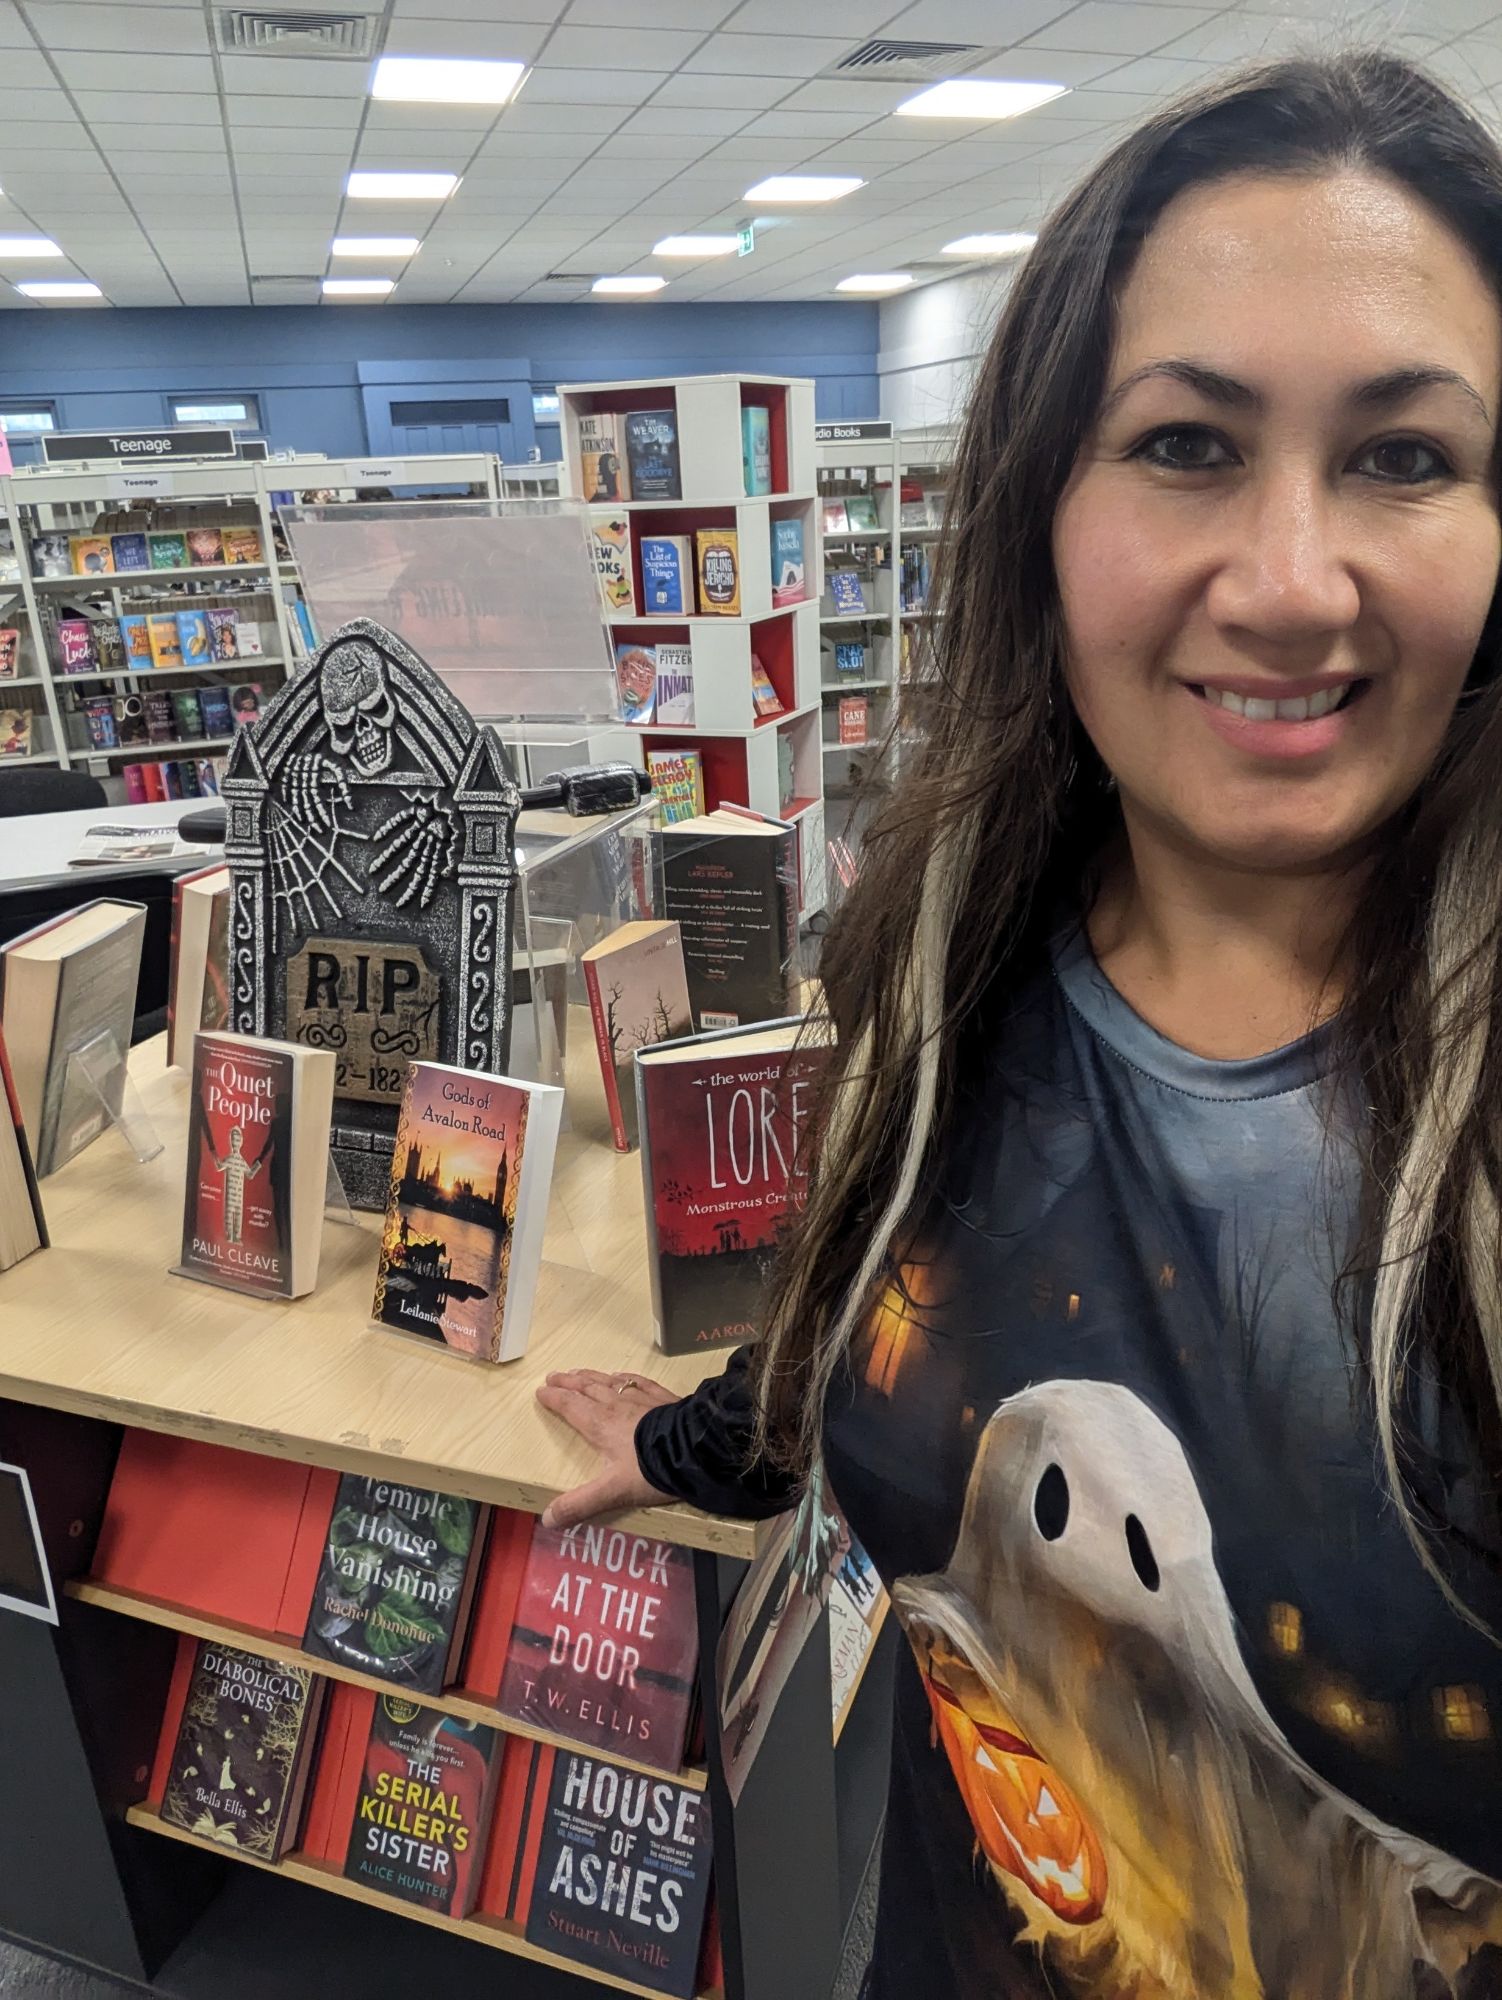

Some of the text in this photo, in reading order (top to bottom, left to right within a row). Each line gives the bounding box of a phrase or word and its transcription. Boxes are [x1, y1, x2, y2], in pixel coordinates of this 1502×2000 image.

[109, 437, 172, 453] Teenage
[633, 425, 669, 435] WEAVER
[815, 426, 861, 438] udio Books
[123, 479, 158, 488] Teenage
[360, 470, 391, 478] Teenage
[645, 559, 677, 569] Suspicious
[650, 552, 664, 561] List
[652, 545, 664, 553] The
[650, 568, 674, 579] Things
[704, 572, 735, 586] JERICHO
[706, 558, 732, 573] KILLING
[660, 654, 692, 665] FITZEK
[658, 675, 694, 707] INMAT
[650, 758, 687, 775] JAMES
[651, 769, 692, 787] ELLROY
[304, 952, 421, 1016] RIP
[220, 1062, 275, 1099] Quiet
[710, 1072, 735, 1086] the
[738, 1065, 781, 1083] world
[208, 1086, 271, 1129] People
[442, 1082, 491, 1110] Gods of
[421, 1104, 506, 1141] Avalon Road
[707, 1081, 809, 1189] LORE
[686, 1197, 762, 1216] Monstrous
[193, 1238, 224, 1259] PAUL
[228, 1248, 279, 1273] CLEAVE
[400, 1299, 477, 1338] Leilanie Stewart
[361, 1475, 452, 1521] Temple
[356, 1514, 438, 1555] House
[559, 1522, 673, 1588] KNOCK
[329, 1544, 456, 1611] Vanishing
[324, 1597, 436, 1644] Rachel Donohue
[551, 1572, 661, 1639] AT THE
[248, 1656, 262, 1667] THE
[550, 1624, 640, 1690] DOOR
[202, 1654, 302, 1701] DIABOLICAL
[219, 1680, 275, 1713] BONES
[579, 1699, 650, 1740] ELLIS
[389, 1740, 410, 1752] unless
[435, 1754, 449, 1763] you
[399, 1730, 420, 1745] Family
[407, 1759, 442, 1785] THE
[196, 1787, 247, 1819] Bella Ellis
[375, 1772, 463, 1821] SERIAL
[562, 1757, 701, 1846] HOUSE
[360, 1795, 470, 1851] KILLER'S
[365, 1827, 450, 1876] SISTER
[609, 1829, 637, 1859] OF
[359, 1860, 449, 1900] ALICE HUNTER
[549, 1845, 683, 1933] ASHES
[548, 1911, 671, 1969] Stuart Neville
